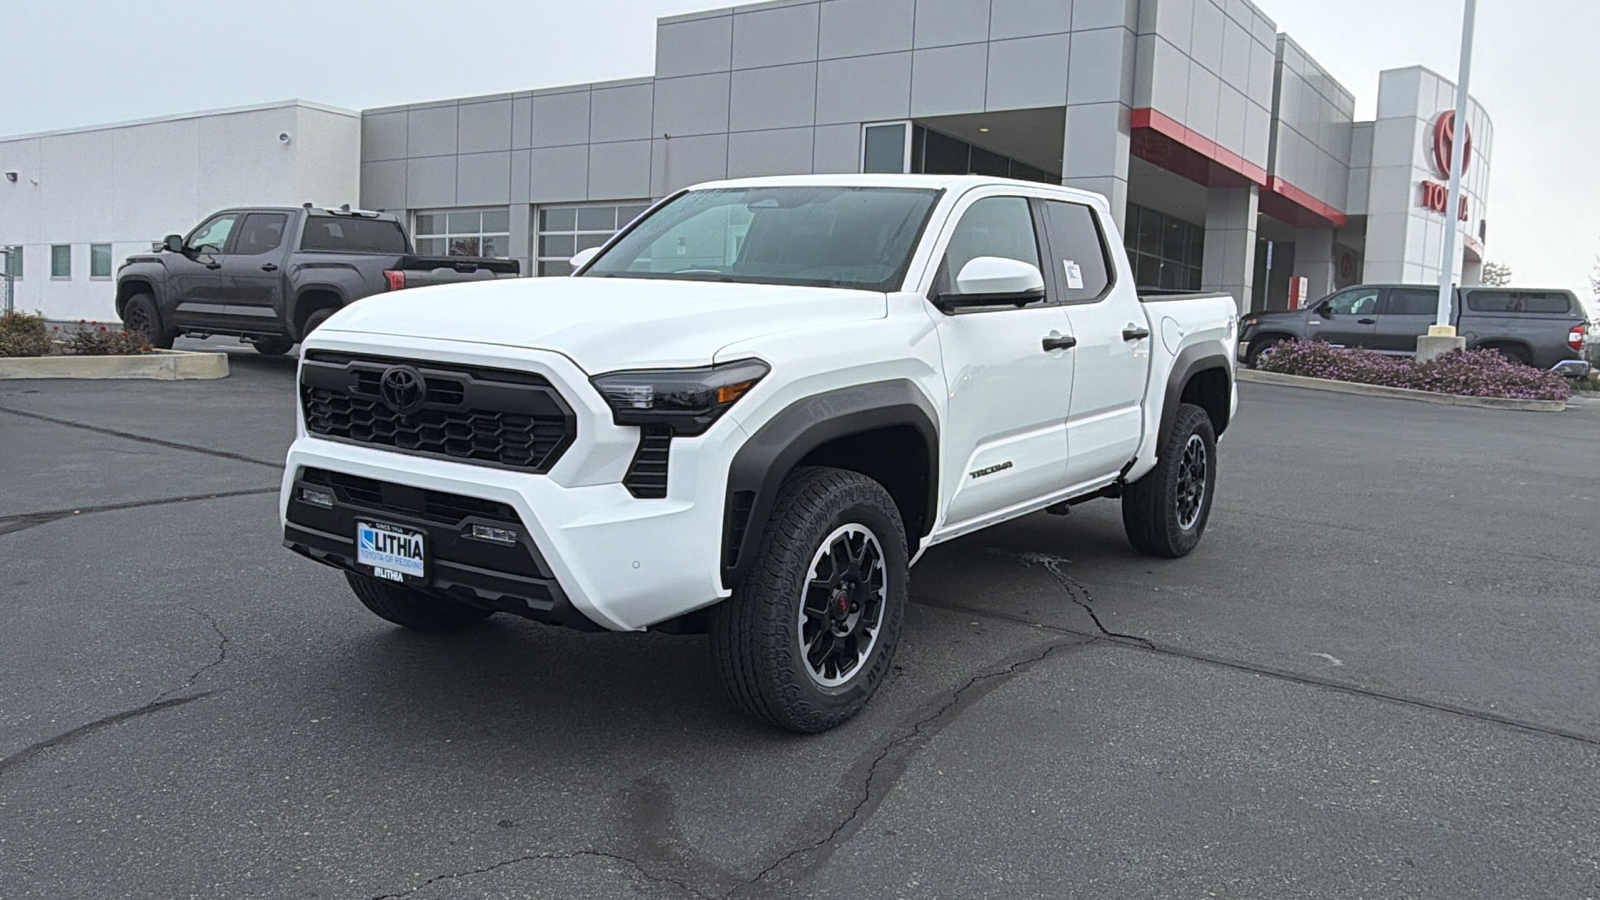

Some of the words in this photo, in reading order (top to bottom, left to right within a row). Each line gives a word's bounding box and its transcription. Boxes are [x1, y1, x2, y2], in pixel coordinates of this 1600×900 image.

[1422, 180, 1468, 222] TOTA
[969, 461, 1013, 479] TACOMA
[374, 531, 423, 561] LITHIA
[361, 549, 384, 562] TOYOTA
[385, 555, 394, 564] OF
[380, 567, 404, 582] LITHIA
